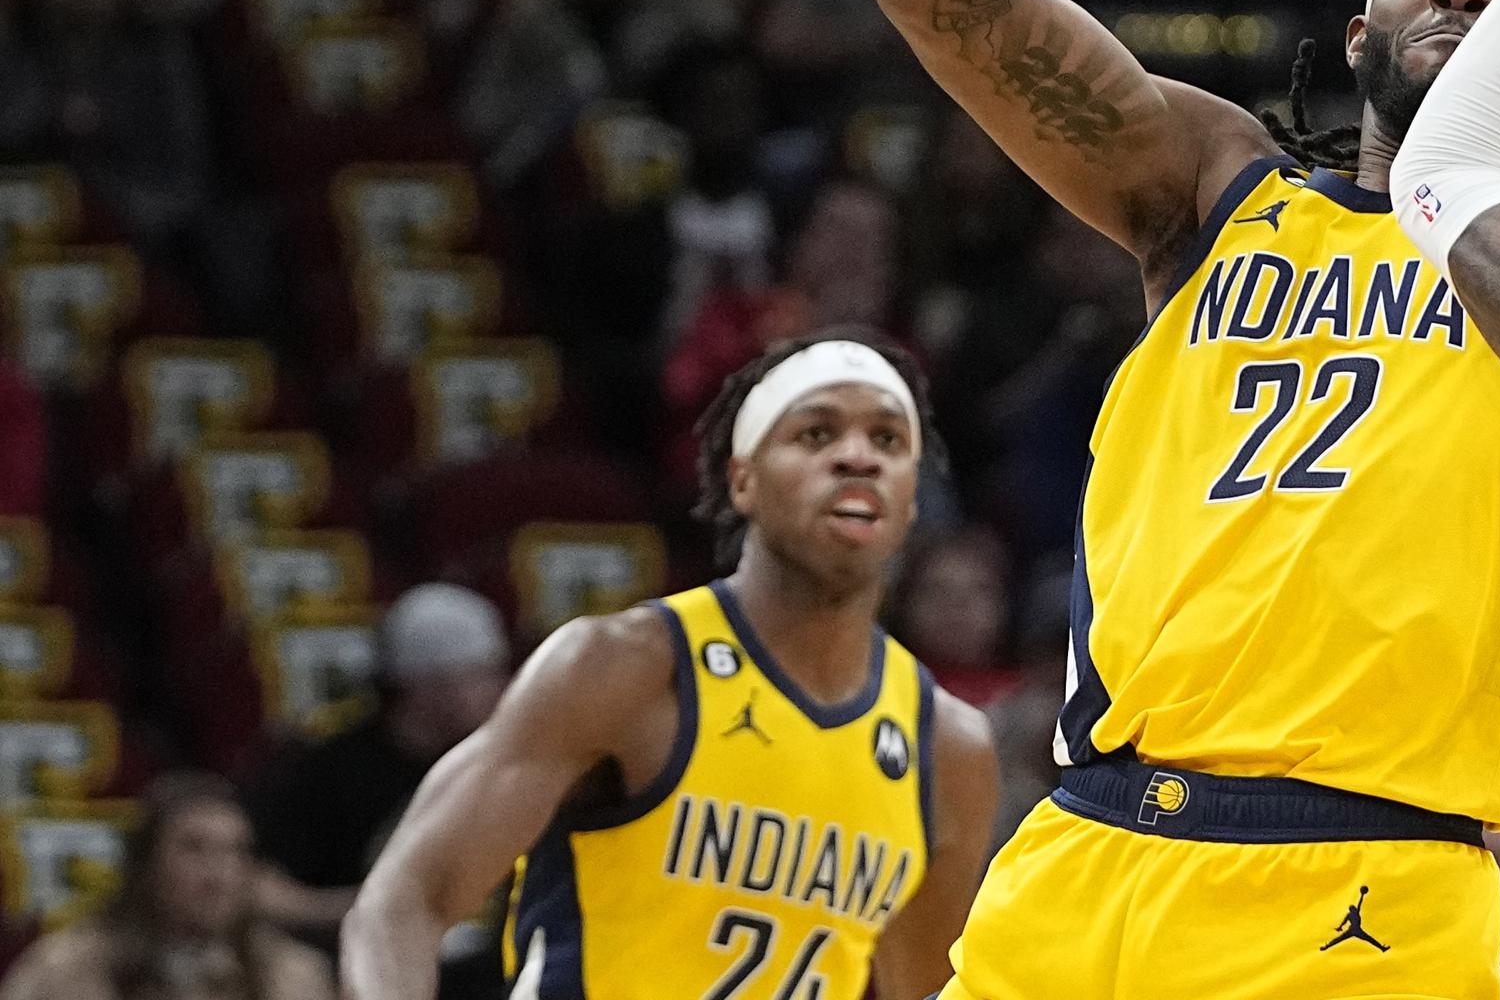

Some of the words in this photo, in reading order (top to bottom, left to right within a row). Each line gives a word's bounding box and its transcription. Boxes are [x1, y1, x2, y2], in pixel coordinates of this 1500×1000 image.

[1203, 352, 1384, 505] 22
[705, 642, 737, 677] 6
[663, 794, 914, 925] INDIANA
